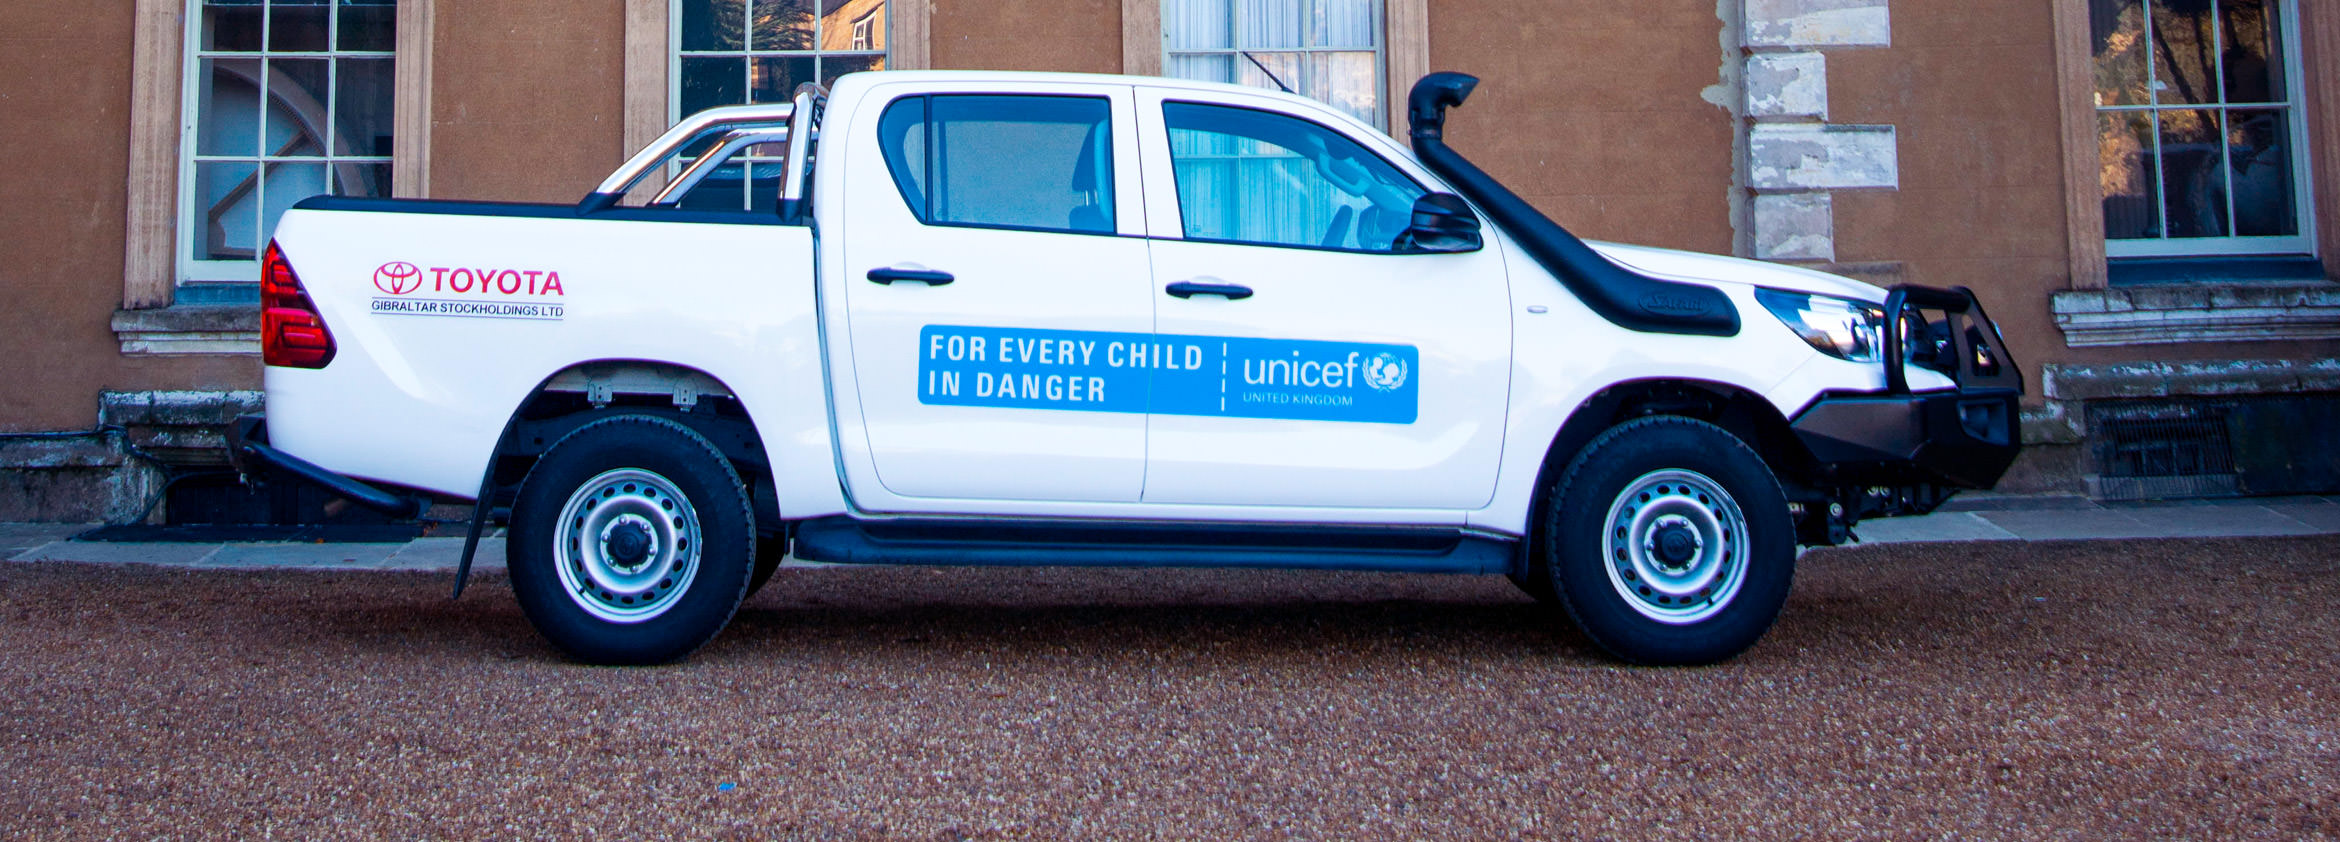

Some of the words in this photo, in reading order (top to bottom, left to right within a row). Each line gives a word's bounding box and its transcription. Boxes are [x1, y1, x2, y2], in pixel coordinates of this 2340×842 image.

[430, 267, 564, 296] TOYOTA
[371, 300, 437, 313] GIBRALTAR
[440, 303, 539, 316] STOCKHOLDINGS
[541, 306, 564, 317] LTD
[930, 334, 986, 361] FOR
[1000, 337, 1096, 366] EVERY
[1107, 341, 1202, 370] CHILD
[1244, 350, 1359, 388] unicef
[929, 370, 960, 396] IN
[976, 372, 1105, 402] DANGER
[1243, 392, 1289, 404] UNITED
[1292, 393, 1353, 406] KINGDOM
